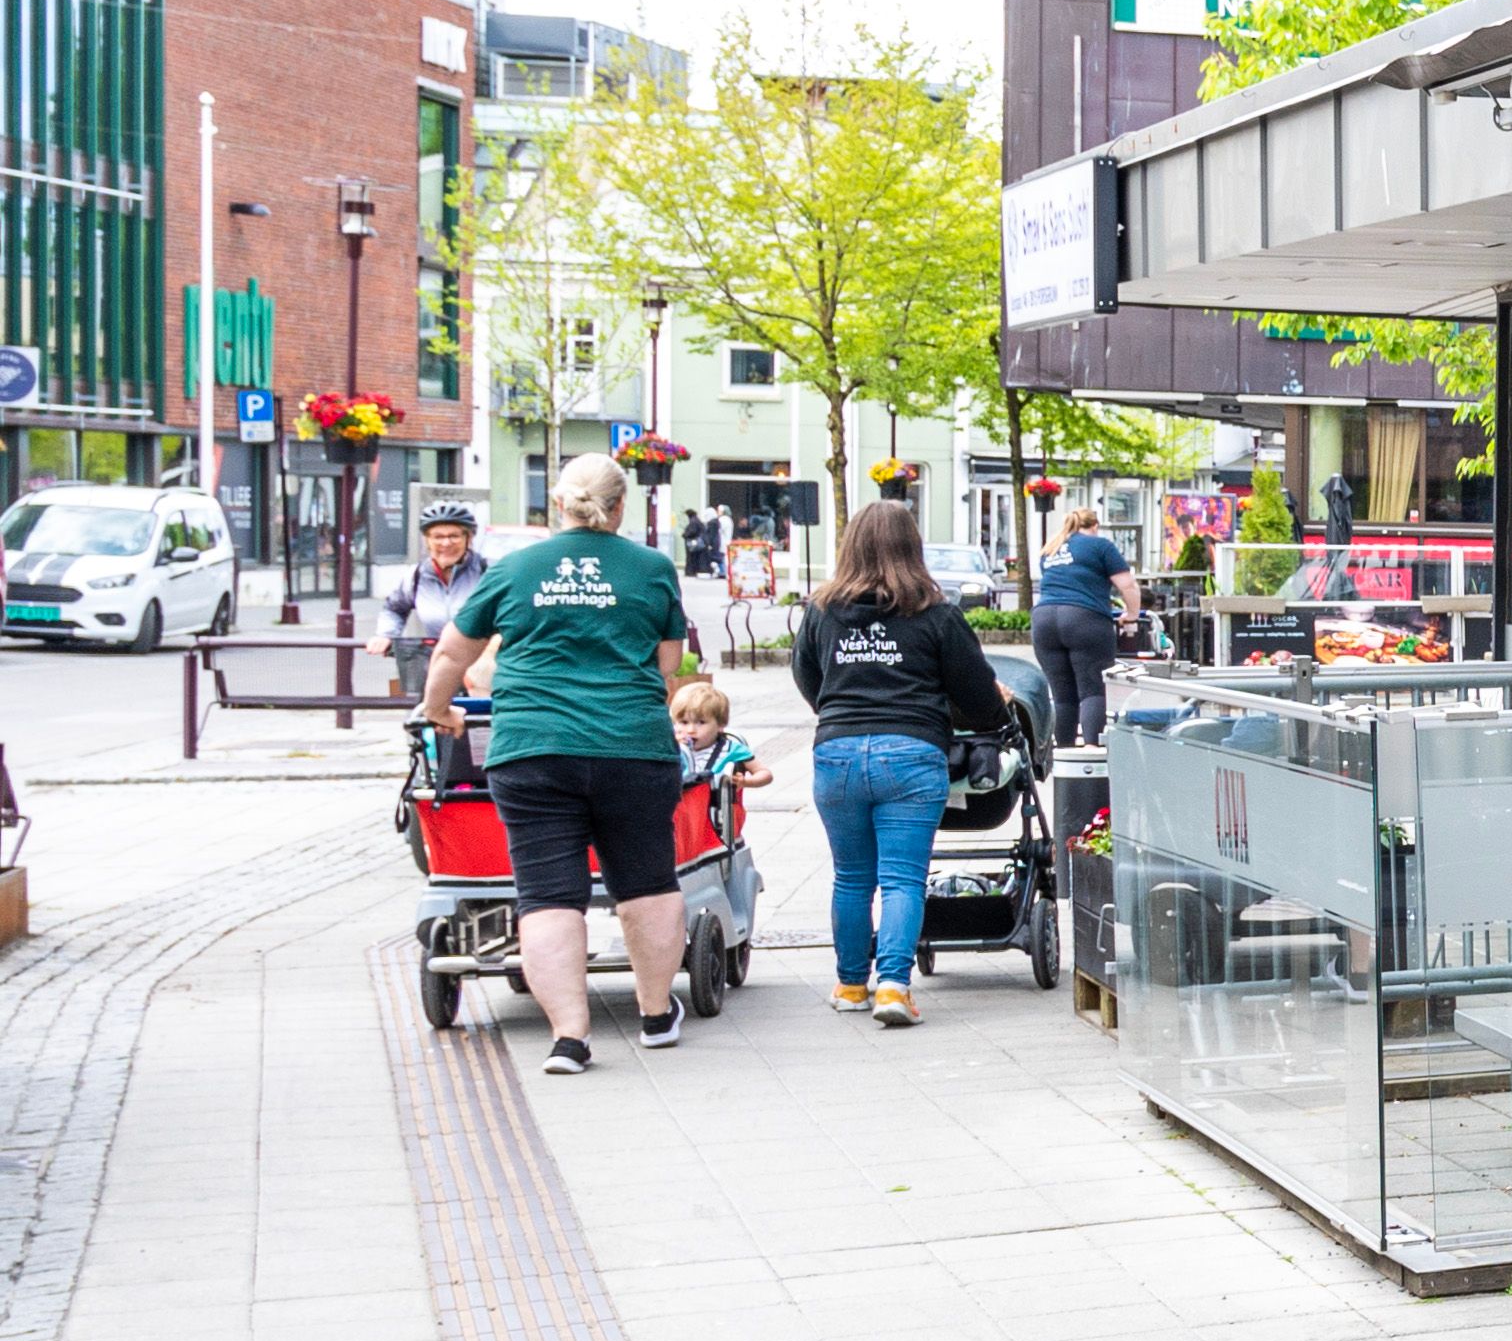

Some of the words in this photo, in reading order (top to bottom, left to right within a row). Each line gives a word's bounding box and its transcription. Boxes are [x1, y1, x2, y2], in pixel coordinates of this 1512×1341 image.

[246, 394, 265, 419] P
[541, 581, 612, 593] Vest-tun
[533, 592, 617, 609] Barnehage
[839, 639, 897, 651] Vest-tun
[836, 650, 903, 665] Barnehage
[1215, 765, 1250, 865] CAVA
